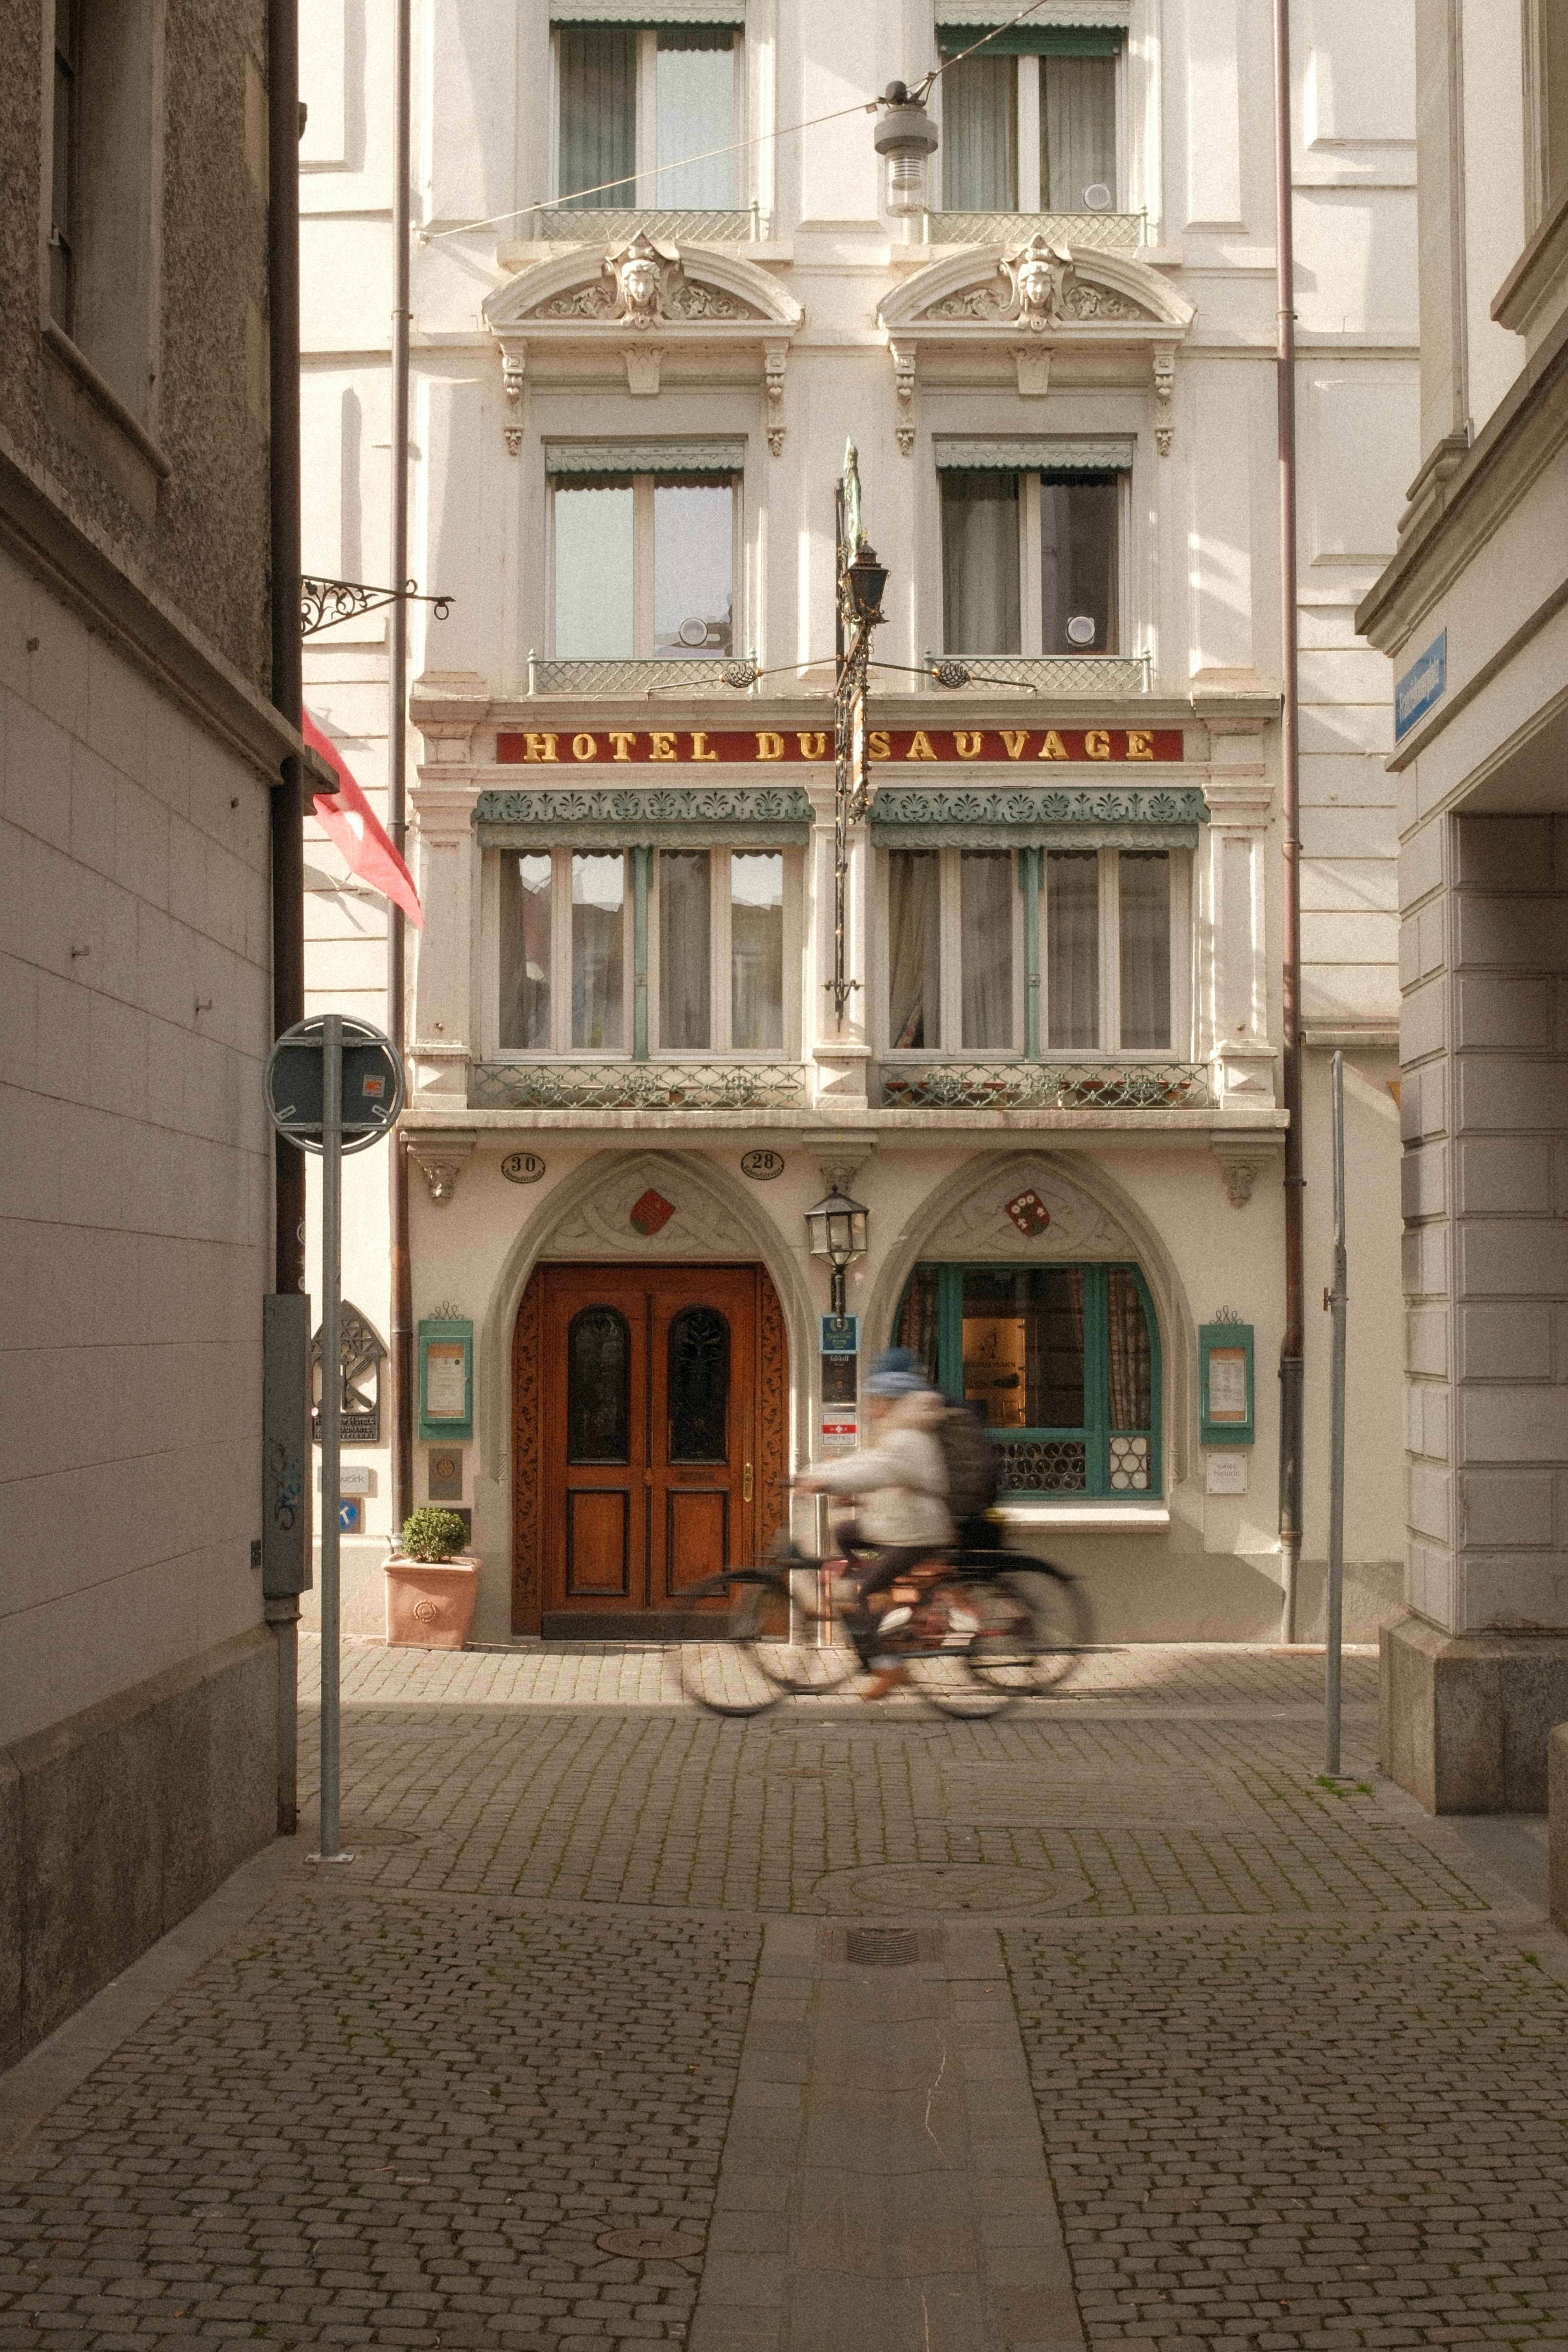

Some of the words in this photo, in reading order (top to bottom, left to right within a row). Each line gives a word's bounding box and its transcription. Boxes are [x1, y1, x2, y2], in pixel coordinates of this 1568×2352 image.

[523, 732, 719, 763] HOTEL
[755, 732, 828, 762] DU
[868, 730, 1154, 761] SAUVAGE
[511, 1156, 535, 1172] 30
[752, 1153, 774, 1169] 28
